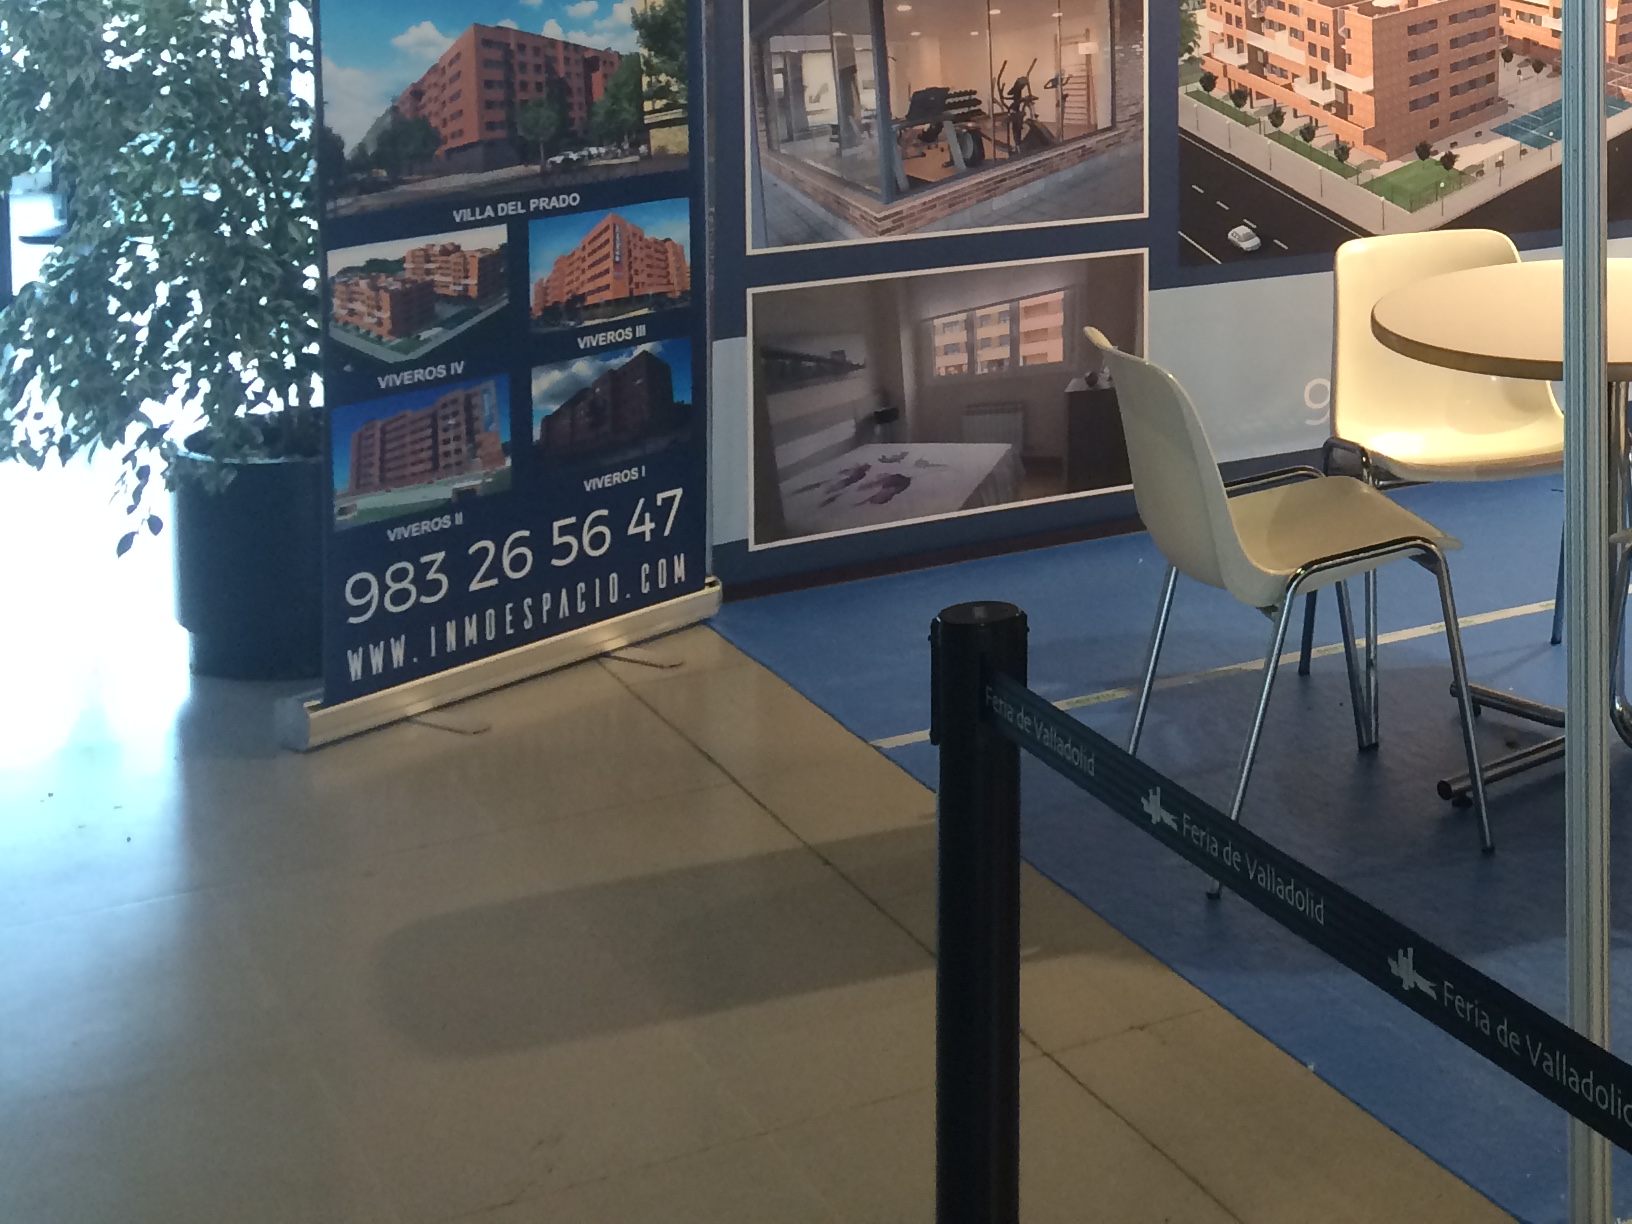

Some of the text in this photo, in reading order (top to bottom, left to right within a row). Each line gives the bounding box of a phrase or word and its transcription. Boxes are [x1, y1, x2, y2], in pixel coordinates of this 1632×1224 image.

[453, 192, 581, 223] VILLA DEL PRADO
[577, 324, 647, 350] VIVEROS III
[377, 360, 465, 389] VIVEROS IV
[583, 467, 639, 492] VIVEROS
[386, 516, 452, 542] VIVEROS
[345, 488, 684, 624] 983 26 56 47
[346, 553, 686, 681] WWW.INMOESPACIO.COM
[985, 685, 1096, 776] Feria de Valladolid
[1181, 812, 1326, 925] Feria de Valladolid
[1443, 981, 1491, 1036] Feria
[1496, 1017, 1521, 1056] de
